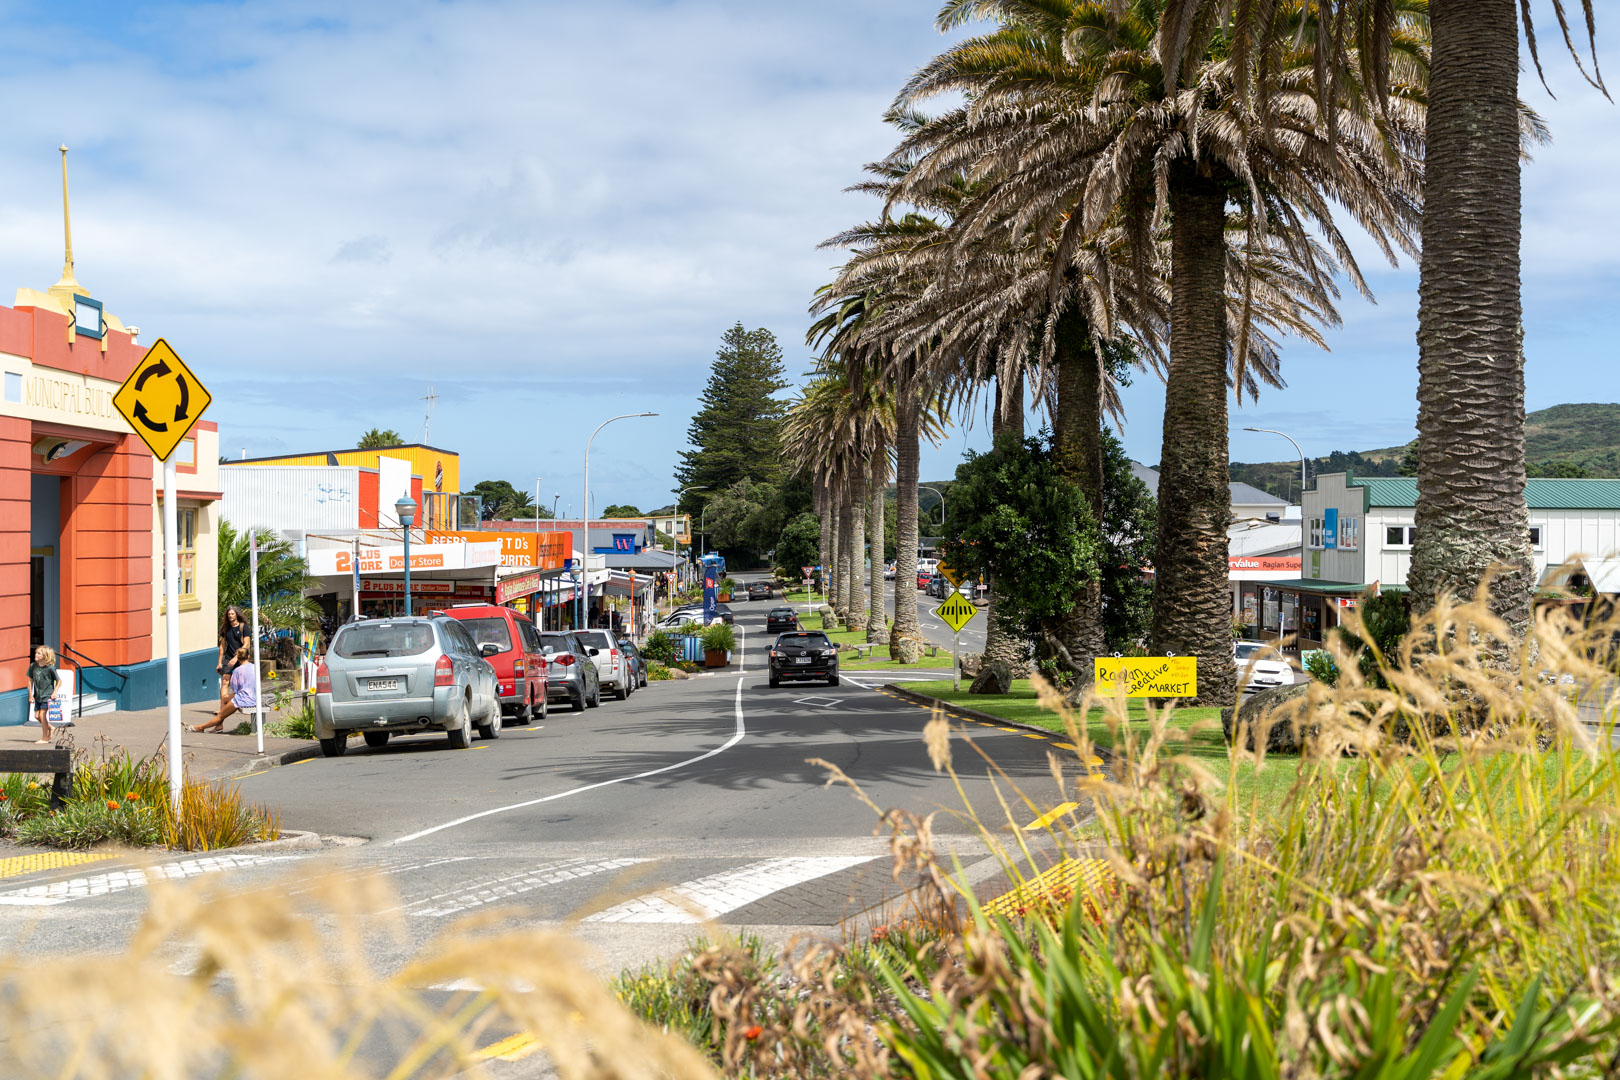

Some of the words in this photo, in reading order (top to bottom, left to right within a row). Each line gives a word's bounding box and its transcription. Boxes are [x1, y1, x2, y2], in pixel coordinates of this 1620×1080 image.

[26, 377, 82, 413] MUNICIPAL
[616, 538, 632, 550] W
[336, 551, 350, 572] 2
[360, 550, 380, 560] LUS
[390, 558, 416, 567] Dolar
[418, 558, 441, 566] Store
[500, 554, 530, 566] PIRITS
[1148, 682, 1190, 694] MARKET
